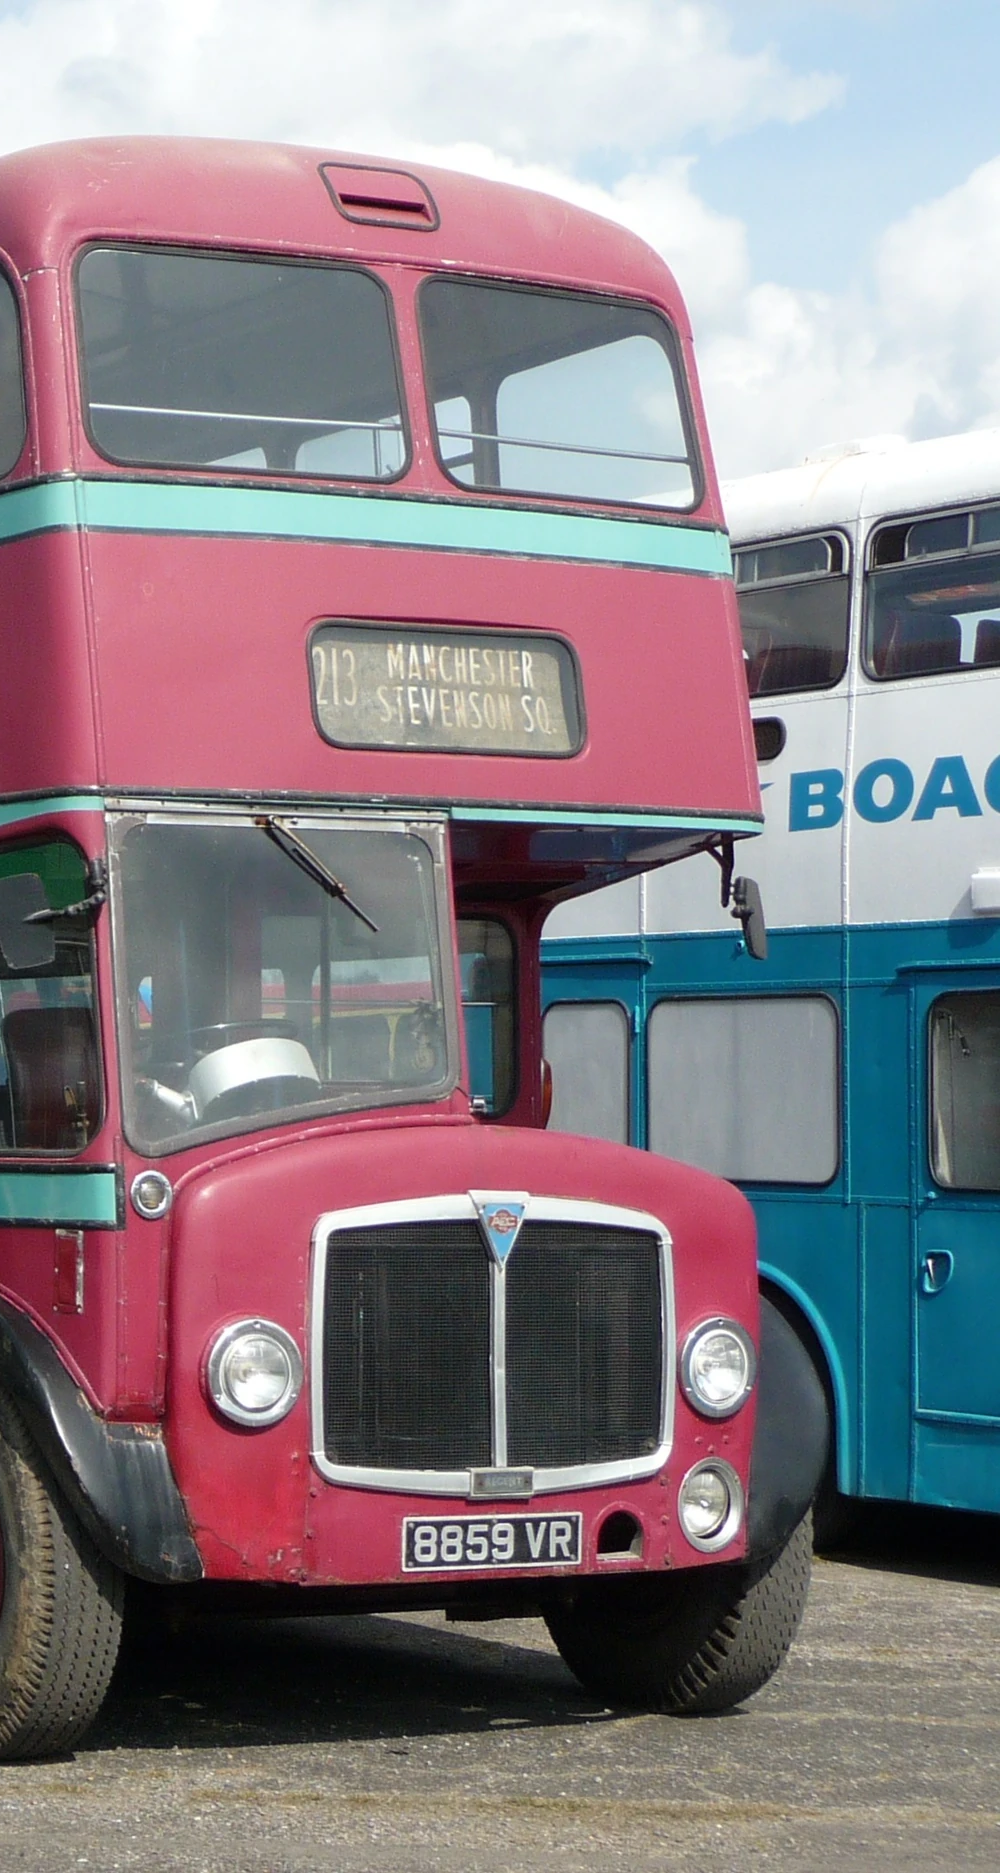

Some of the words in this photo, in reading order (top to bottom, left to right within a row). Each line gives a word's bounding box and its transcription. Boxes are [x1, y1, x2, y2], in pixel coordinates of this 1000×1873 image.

[312, 646, 358, 706] 213
[387, 641, 534, 689] MANCHESTER
[376, 686, 514, 731] STEVENSON
[521, 695, 558, 734] SQ.
[789, 754, 1000, 832] BOA
[414, 1522, 515, 1562] 8859
[525, 1521, 571, 1559] VR
